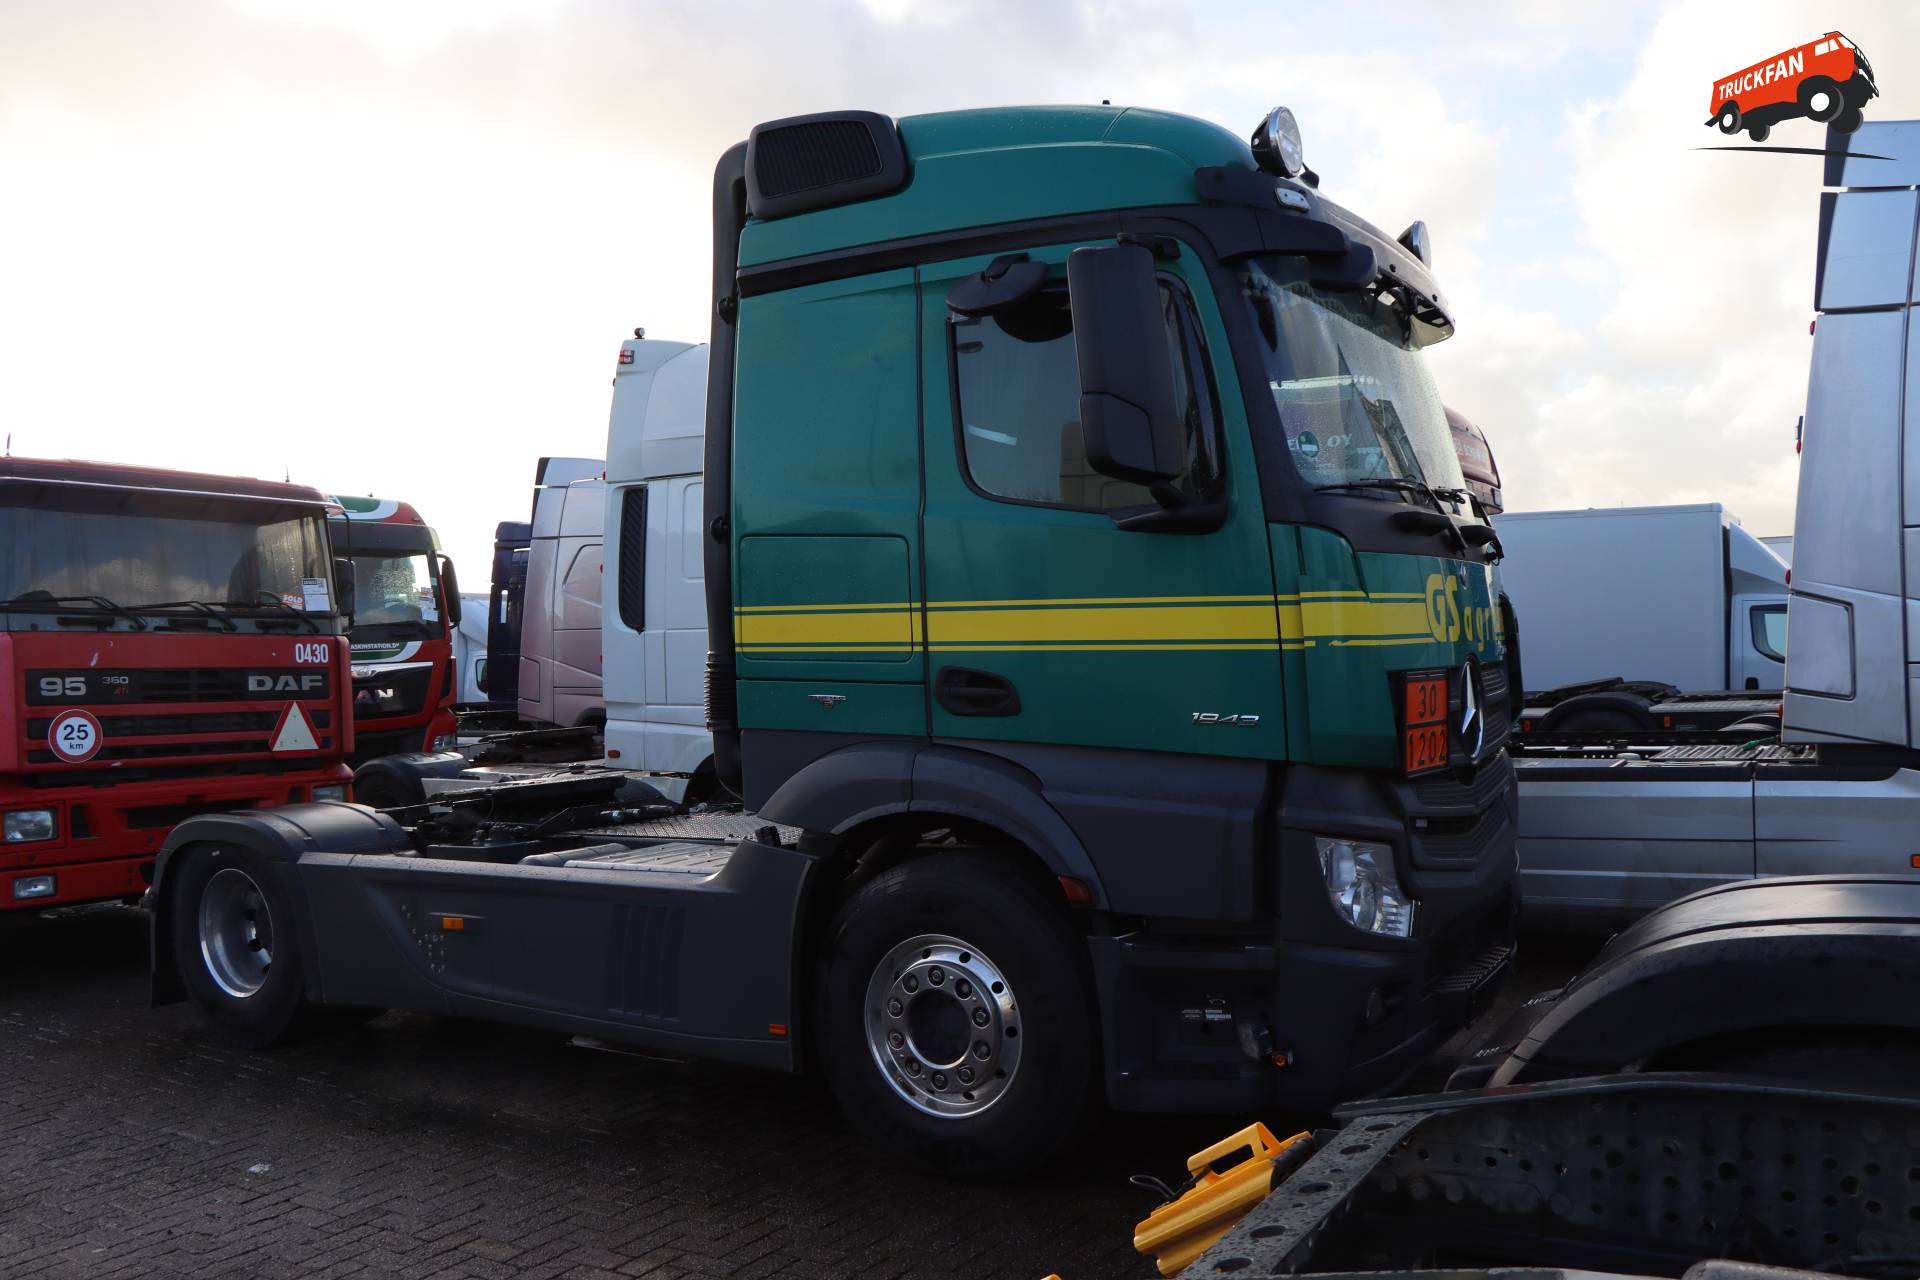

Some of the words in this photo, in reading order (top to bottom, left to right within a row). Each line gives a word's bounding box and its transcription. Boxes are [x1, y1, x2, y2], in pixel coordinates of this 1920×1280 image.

[295, 643, 329, 663] 0430
[40, 677, 87, 696] 95
[248, 675, 323, 691] DAF
[1419, 683, 1438, 718] 30
[63, 724, 89, 741] 25
[69, 742, 84, 750] km
[1407, 728, 1447, 769] 1202
